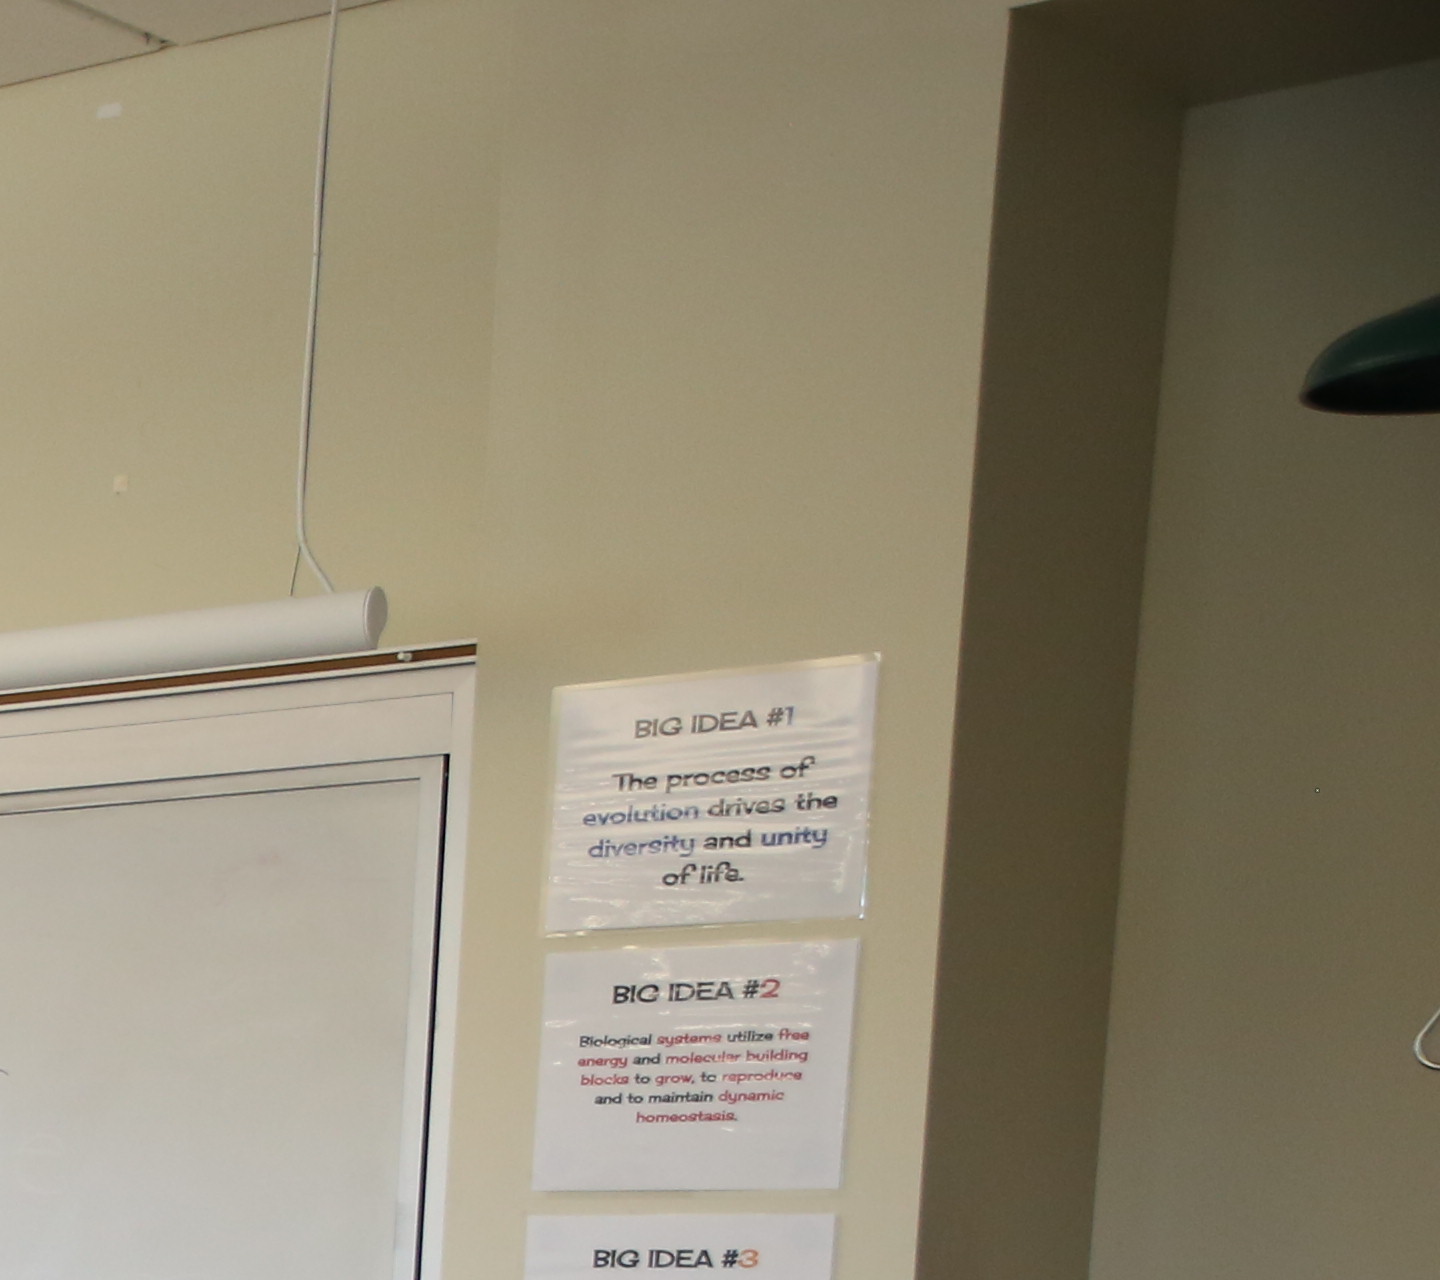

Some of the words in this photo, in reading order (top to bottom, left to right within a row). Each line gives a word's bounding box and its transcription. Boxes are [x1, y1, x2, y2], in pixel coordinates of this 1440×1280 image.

[635, 717, 682, 739] BIG
[691, 709, 757, 734] IDEA
[767, 707, 794, 727] #1
[612, 773, 658, 792] The
[665, 764, 770, 793] process
[780, 756, 815, 778] of
[582, 804, 699, 827] evolution
[706, 799, 785, 817] drives
[795, 793, 838, 811] the
[589, 835, 695, 858] diversity
[703, 830, 751, 850] and
[760, 826, 828, 849] unity
[662, 864, 696, 886] of
[700, 862, 743, 883] life.
[613, 984, 659, 1004] BIG
[668, 982, 734, 1001] IDEA
[743, 979, 779, 998] #2
[580, 1034, 652, 1048] Biological
[657, 1032, 721, 1046] systems
[727, 1031, 773, 1042] utilize
[779, 1029, 809, 1040] free
[578, 1055, 627, 1069] energy
[633, 1053, 660, 1065] and
[666, 1052, 740, 1064] molecular
[746, 1049, 808, 1063] building
[580, 1073, 629, 1085] blocks
[635, 1073, 650, 1083] to
[655, 1073, 694, 1086] grow,
[701, 1072, 716, 1083] to
[722, 1070, 802, 1083] reproduce
[595, 1093, 622, 1105] and
[628, 1094, 643, 1104] to
[649, 1092, 712, 1103] maintain
[719, 1090, 784, 1103] dynamic
[636, 1112, 738, 1123] homeostasis.
[593, 1249, 639, 1268] BIG
[648, 1250, 713, 1268] IDEA
[722, 1250, 758, 1268] #3
